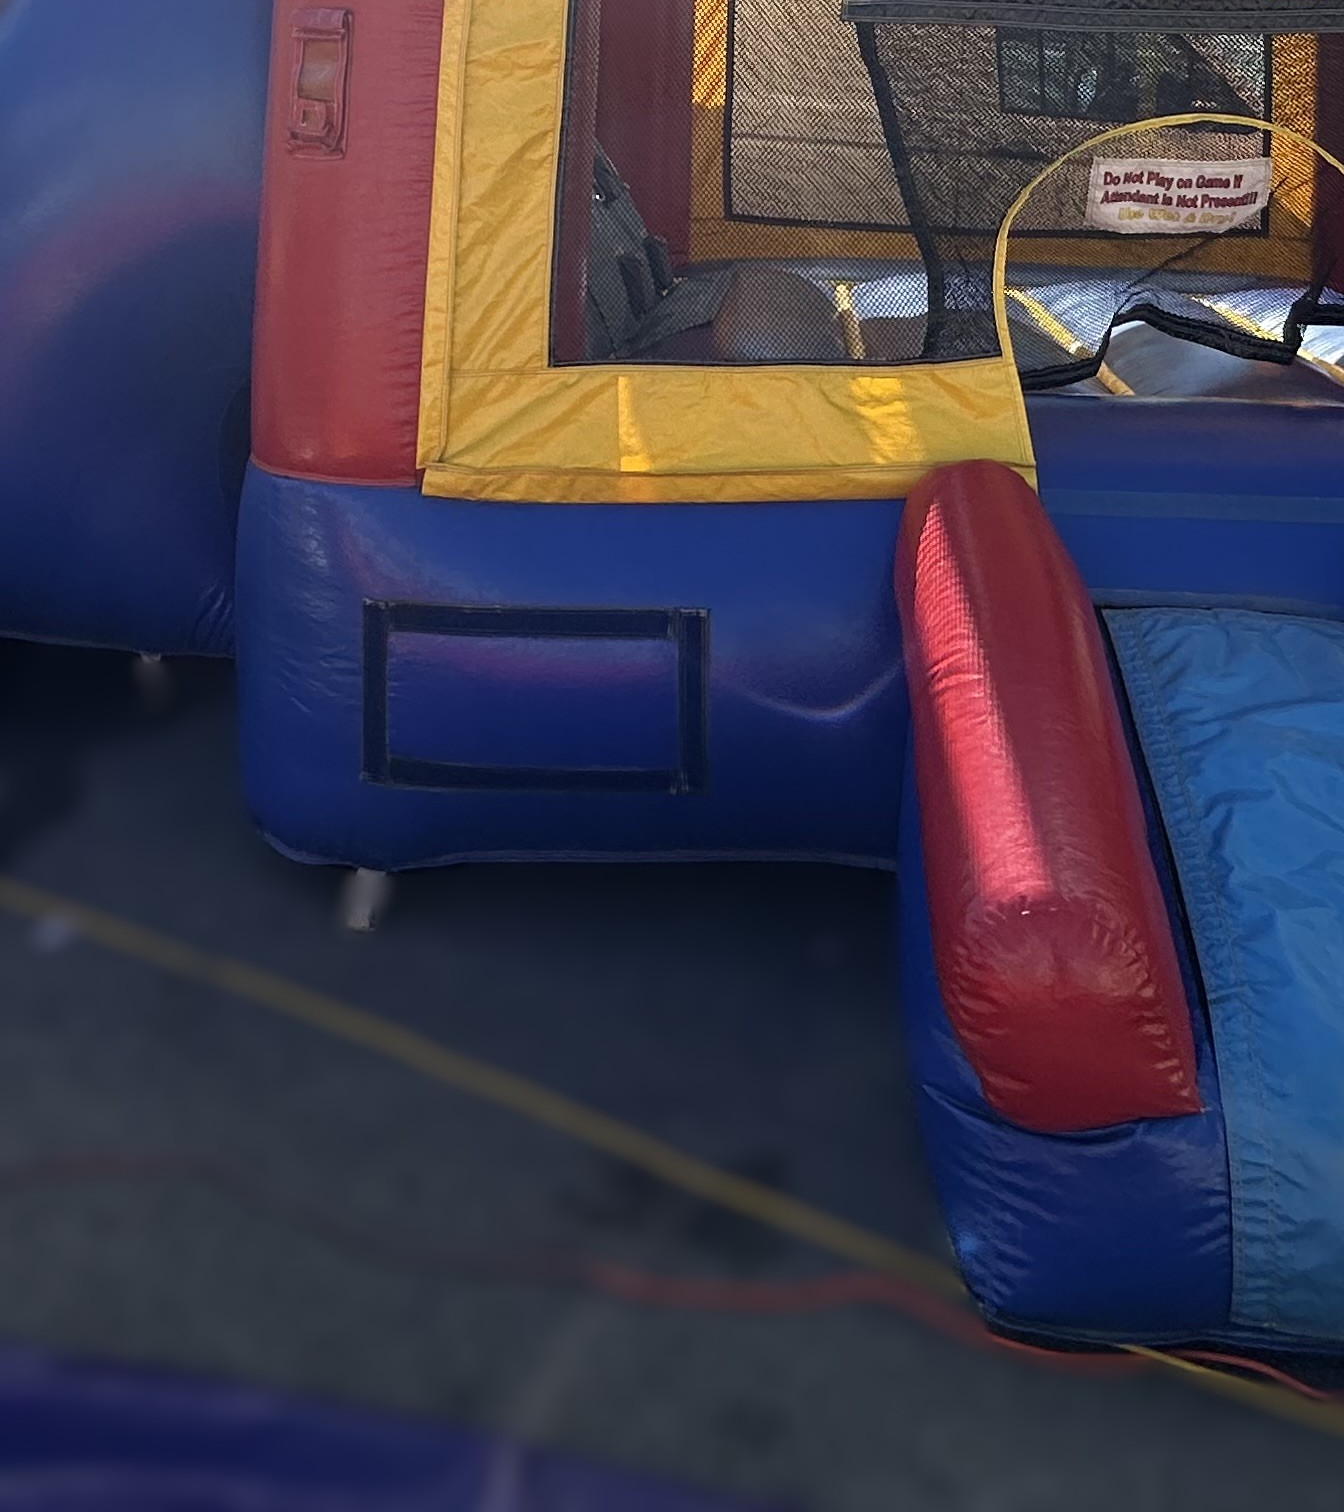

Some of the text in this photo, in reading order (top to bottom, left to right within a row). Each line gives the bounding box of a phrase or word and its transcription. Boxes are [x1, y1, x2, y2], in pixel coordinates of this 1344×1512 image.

[1103, 171, 1121, 186] Do
[1122, 170, 1144, 185] Not
[1146, 171, 1174, 191] Play
[1176, 177, 1193, 190] on
[1195, 174, 1230, 189] Game
[1175, 194, 1198, 209] Not
